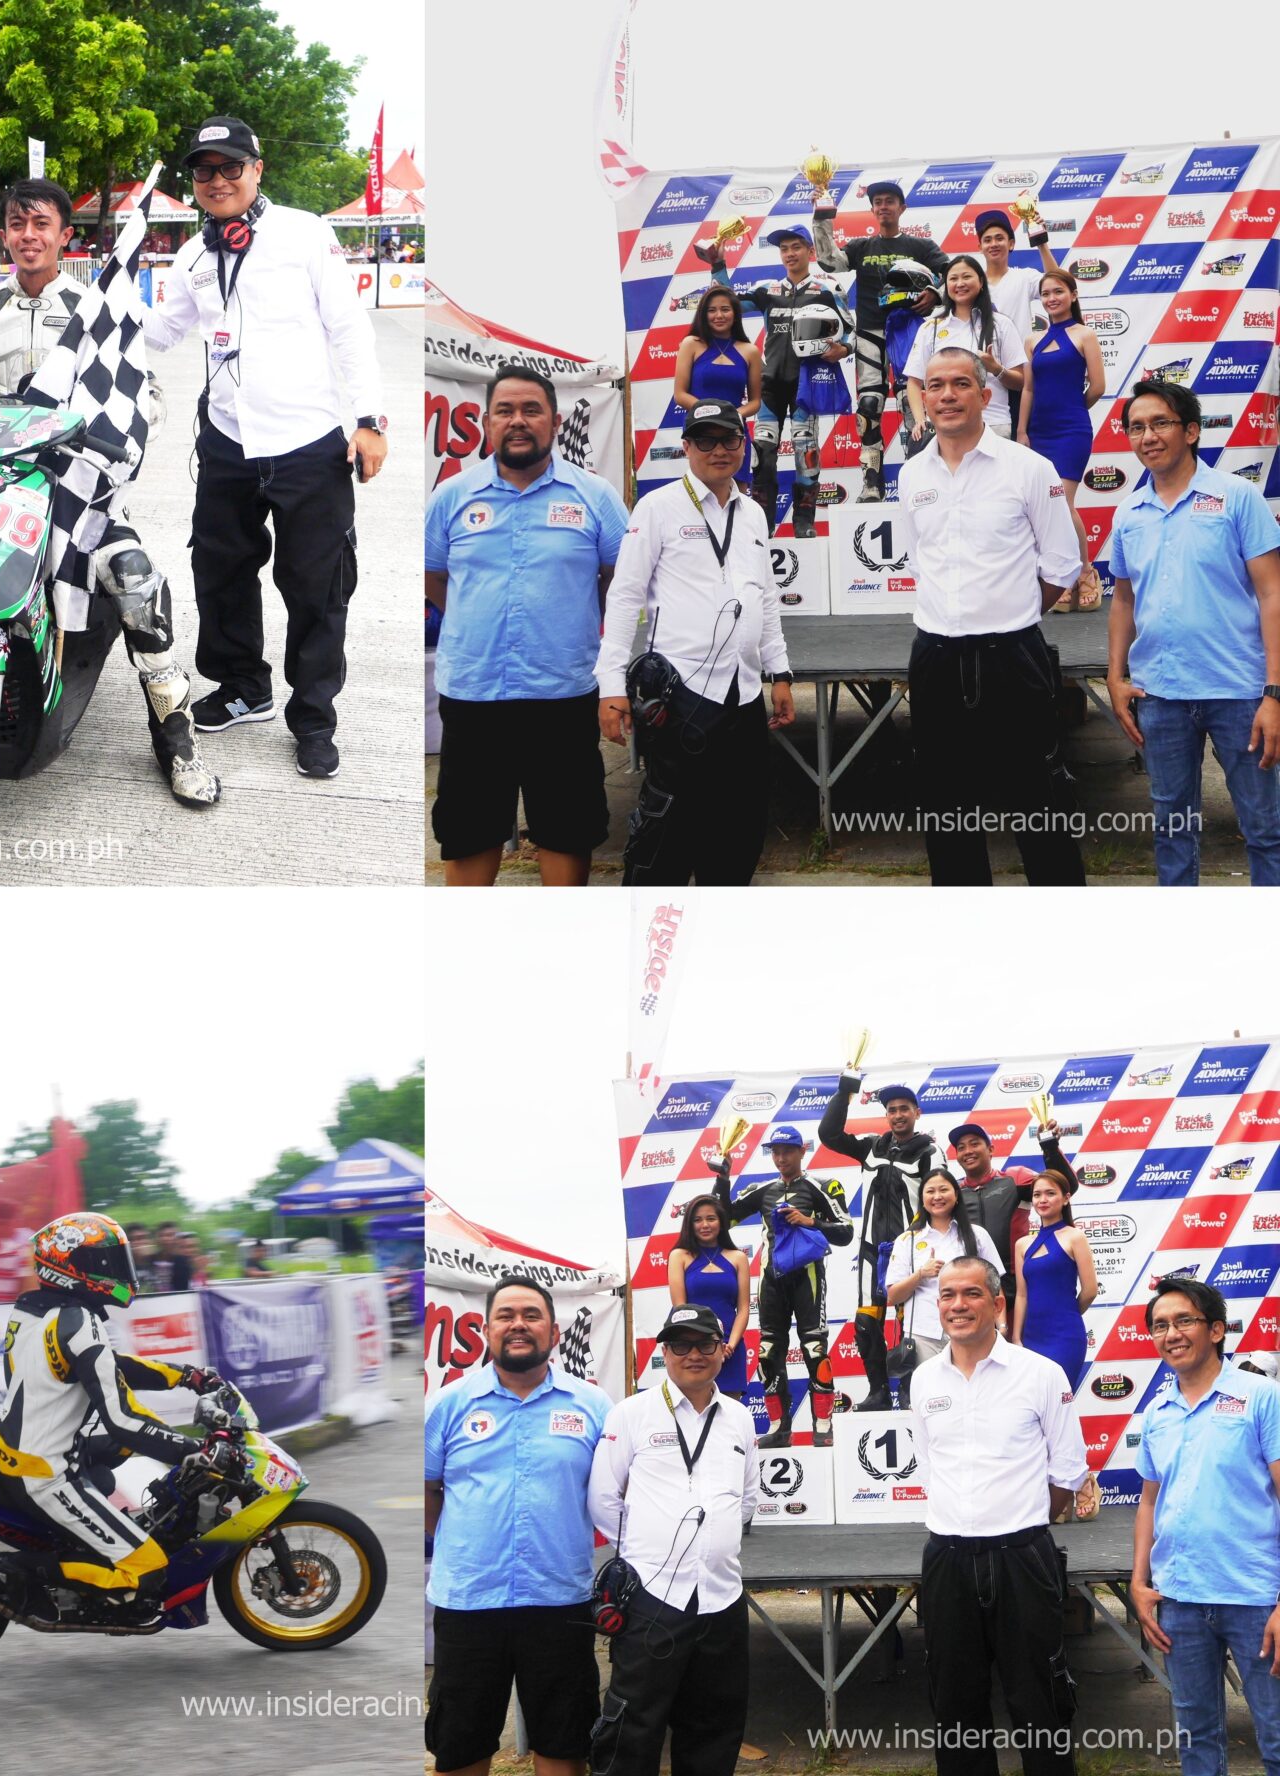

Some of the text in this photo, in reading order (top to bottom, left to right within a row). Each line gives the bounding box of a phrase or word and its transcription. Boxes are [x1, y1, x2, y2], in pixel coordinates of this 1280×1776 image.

[1194, 160, 1212, 168] Shell
[1186, 166, 1239, 178] ADVANCE
[1053, 173, 1106, 184] ADVANCE
[917, 181, 971, 192] ADVANCE
[666, 190, 684, 199] Shell
[657, 196, 709, 209] ADVANCE
[1168, 211, 1195, 220] Inside
[1230, 207, 1248, 216] Shell
[1168, 217, 1205, 227] RACING
[1230, 212, 1274, 223] V-Power
[1096, 221, 1142, 230] V-Power
[640, 243, 666, 253] Inside
[640, 250, 673, 261] RACING
[1129, 265, 1184, 276] ADVANCE
[1176, 313, 1218, 322] V-Power
[1243, 311, 1270, 319] Inside
[1243, 317, 1275, 327] RACING
[1214, 357, 1233, 365] Shell
[1206, 364, 1260, 375] ADVANCE
[1194, 503, 1222, 511] USRA
[551, 514, 581, 523] USRA
[870, 520, 892, 560] 1
[770, 549, 786, 575] 2
[848, 583, 882, 591] ADVANCE
[1194, 1068, 1249, 1079] ADVANCE
[930, 1079, 949, 1087] Shell
[1009, 1080, 1040, 1089] SERIES
[1058, 1076, 1112, 1088] ADVANCE
[799, 1088, 817, 1096] Shell
[922, 1085, 976, 1097] ADVANCE
[793, 1095, 834, 1107] ADVAN
[660, 1102, 711, 1115] ADVANCE
[1239, 1109, 1257, 1117] Shell
[1103, 1125, 1150, 1134] V-Power
[1175, 1121, 1213, 1130] RACING
[641, 1151, 667, 1160] Inside
[641, 1157, 676, 1168] RACING
[1145, 1163, 1164, 1171] Shell
[1137, 1170, 1192, 1181] ADVANCE
[1184, 1219, 1225, 1228] V-Power
[1084, 1228, 1130, 1237] SERIES
[1106, 1258, 1126, 1266] 2017
[1222, 1262, 1242, 1270] Shell
[1214, 1268, 1271, 1281] ADVANCE
[1118, 1325, 1136, 1333] Shell
[1119, 1333, 1153, 1342] V-Pow
[1216, 1404, 1245, 1412] USRA
[553, 1423, 583, 1432] USRA
[875, 1429, 897, 1468] 1
[770, 1458, 791, 1484] 2
[852, 1492, 886, 1500] ADVANCE
